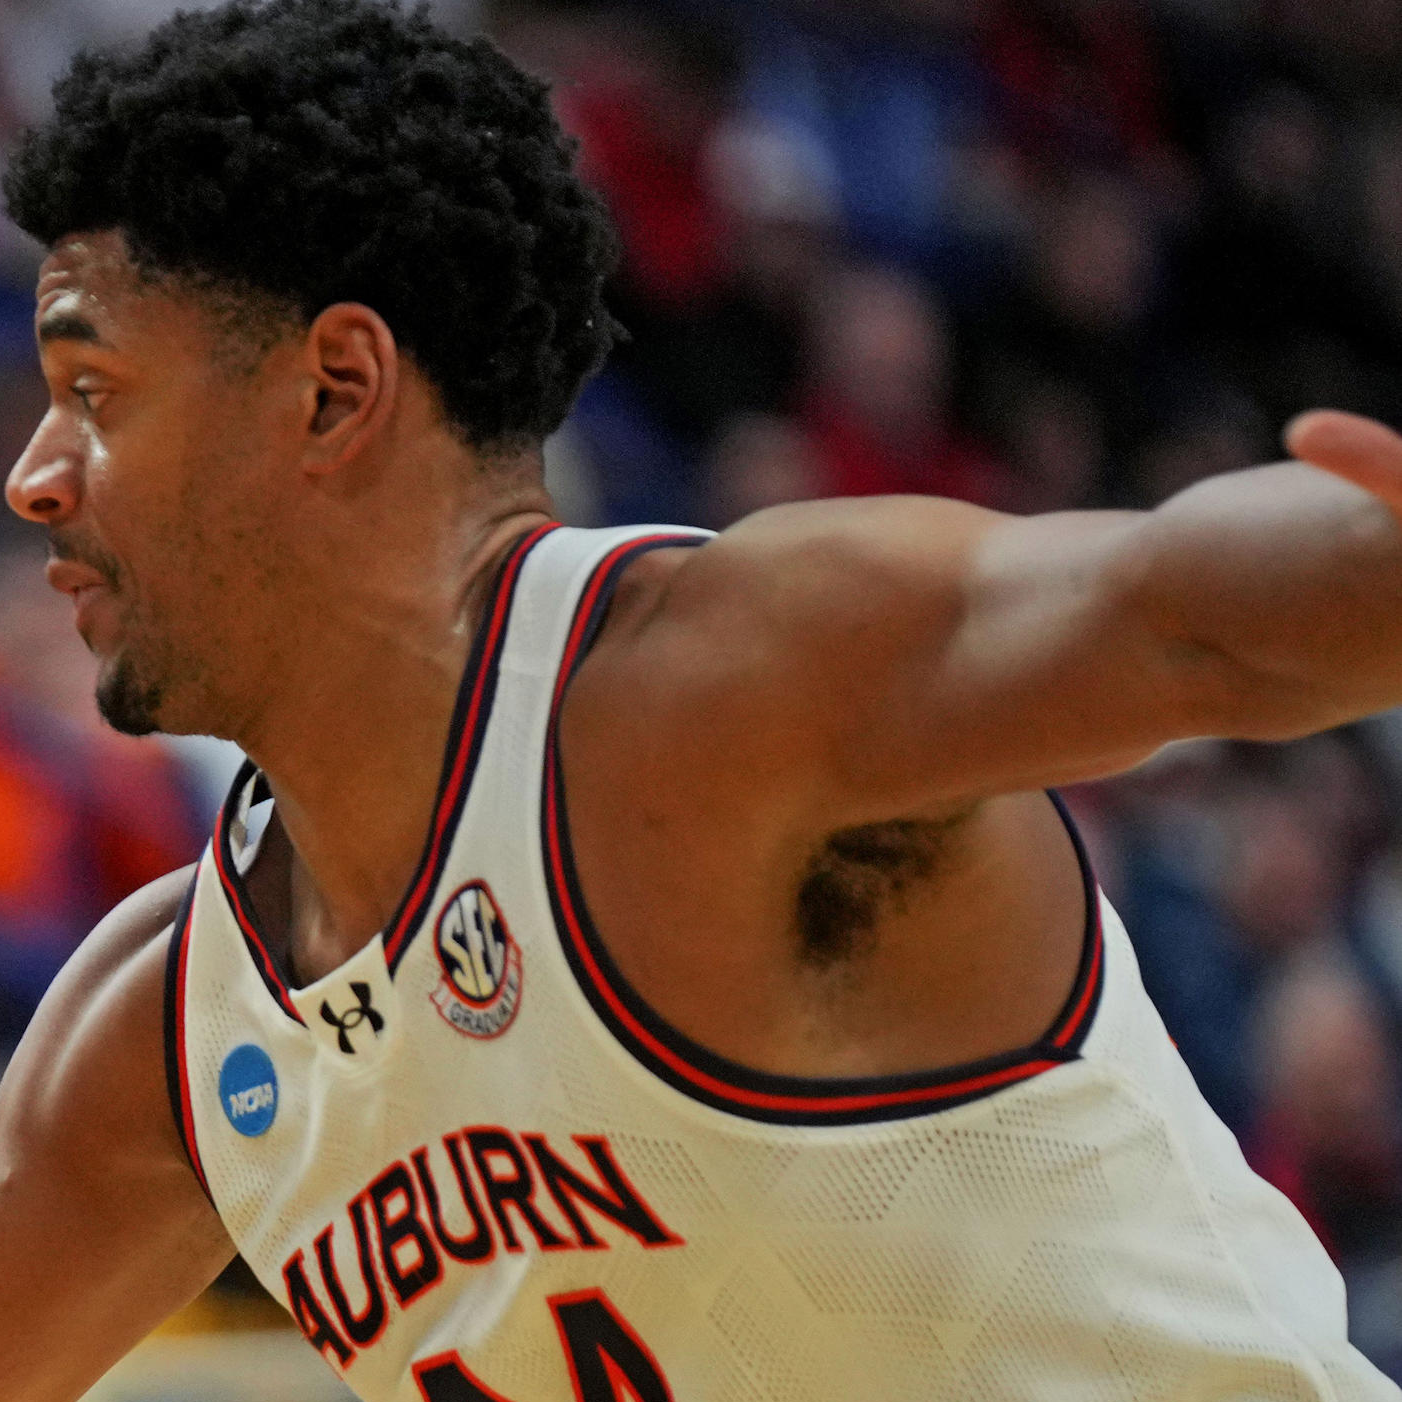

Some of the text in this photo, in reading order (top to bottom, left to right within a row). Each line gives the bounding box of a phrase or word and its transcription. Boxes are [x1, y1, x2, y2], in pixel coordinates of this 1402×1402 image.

[440, 888, 505, 998] SEC
[229, 1082, 274, 1120] NCAA
[282, 1124, 686, 1380] AUBURN
